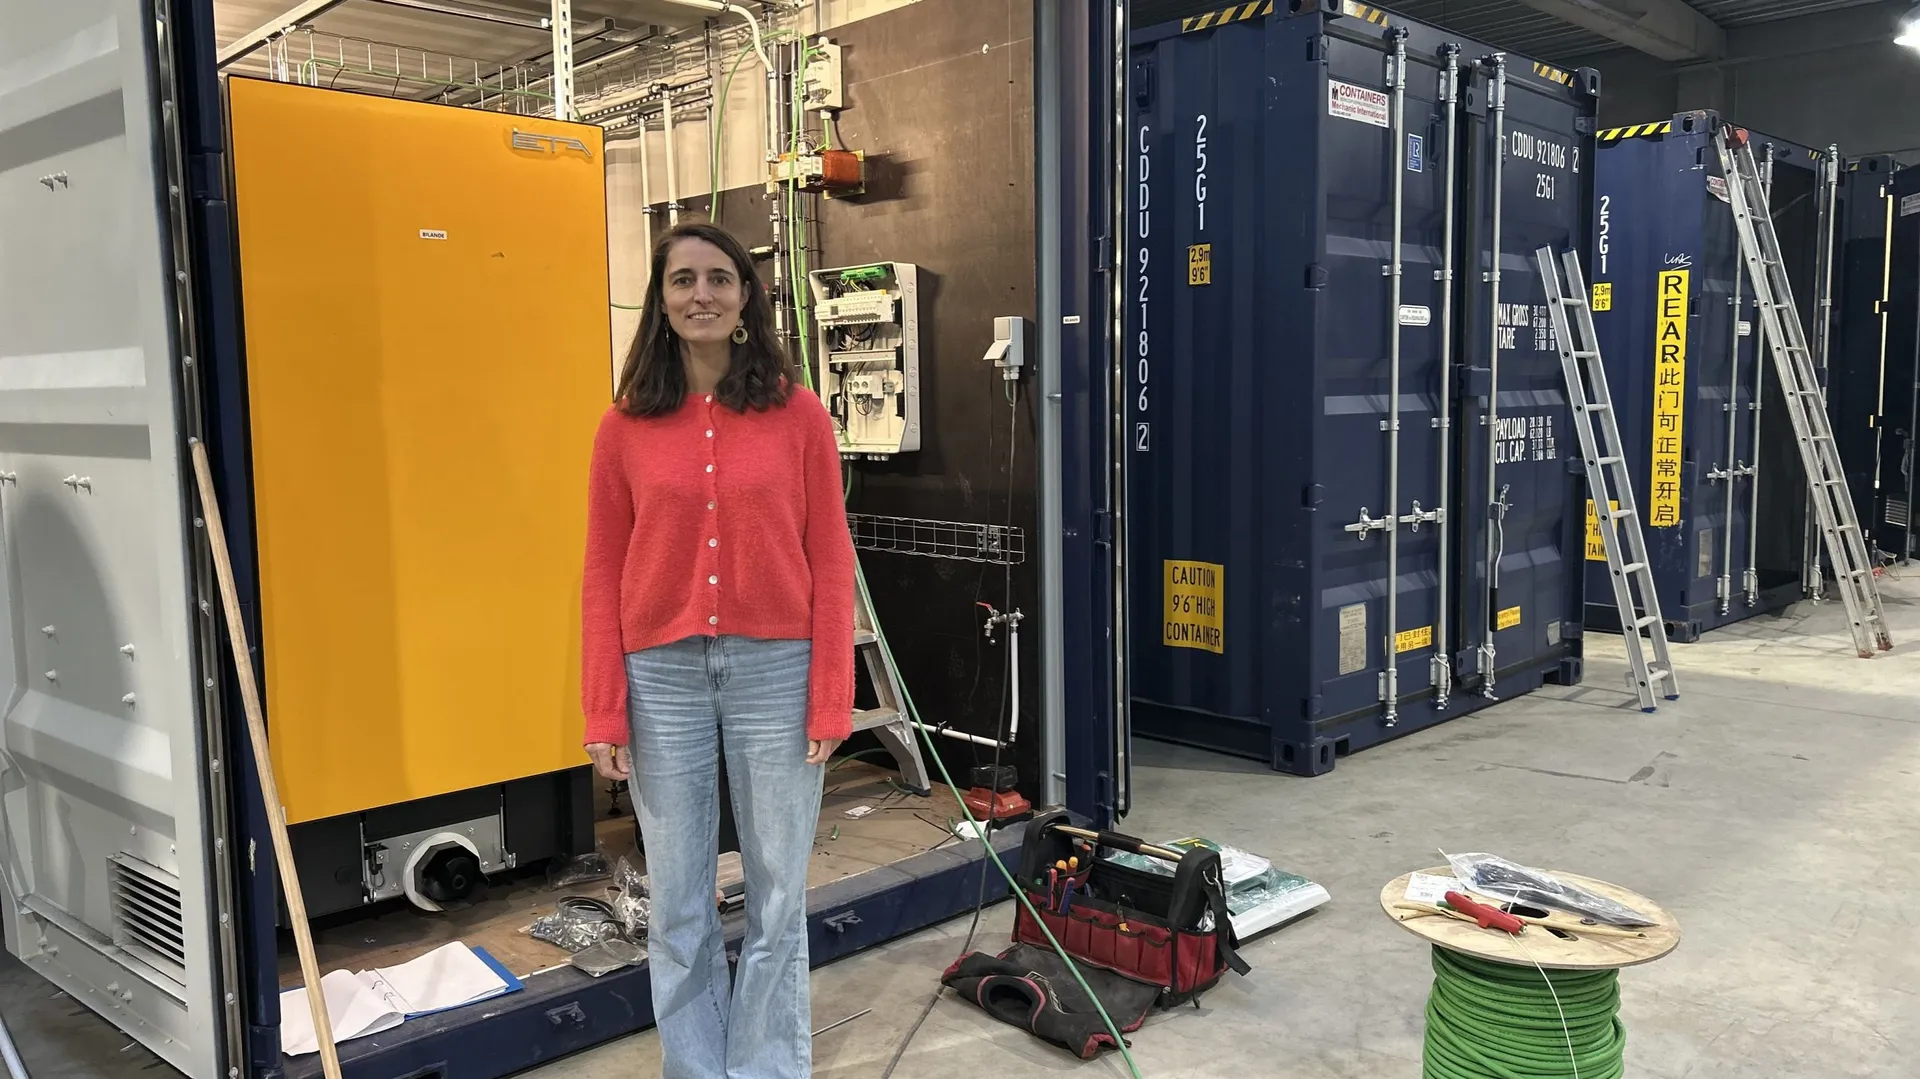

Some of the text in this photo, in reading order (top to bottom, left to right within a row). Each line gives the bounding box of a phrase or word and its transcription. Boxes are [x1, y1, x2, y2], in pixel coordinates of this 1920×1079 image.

[1340, 84, 1386, 107] CONTAINERS
[1331, 100, 1357, 114] Mechanic
[1357, 106, 1387, 121] International
[1512, 130, 1579, 172] CDDU 921806 2
[1195, 114, 1207, 231] 25G1
[1536, 173, 1555, 200] 25G1
[1599, 195, 1610, 274] 25G1
[1190, 247, 1211, 264] 2,9m
[1138, 125, 1150, 450] CDDU 921806 2
[1498, 303, 1511, 326] MAX
[1512, 304, 1528, 327] GROSS
[1660, 275, 1683, 364] REAR
[1498, 326, 1516, 350] TARE
[1495, 416, 1526, 441] PAYLOAD
[1495, 441, 1508, 465] CU.
[1509, 439, 1526, 463] CAP.
[1654, 367, 1681, 523] 此门可正常开启
[1172, 566, 1215, 588] CAUTION
[1196, 596, 1215, 617] HIGH
[1166, 621, 1220, 647] CONTAINER
